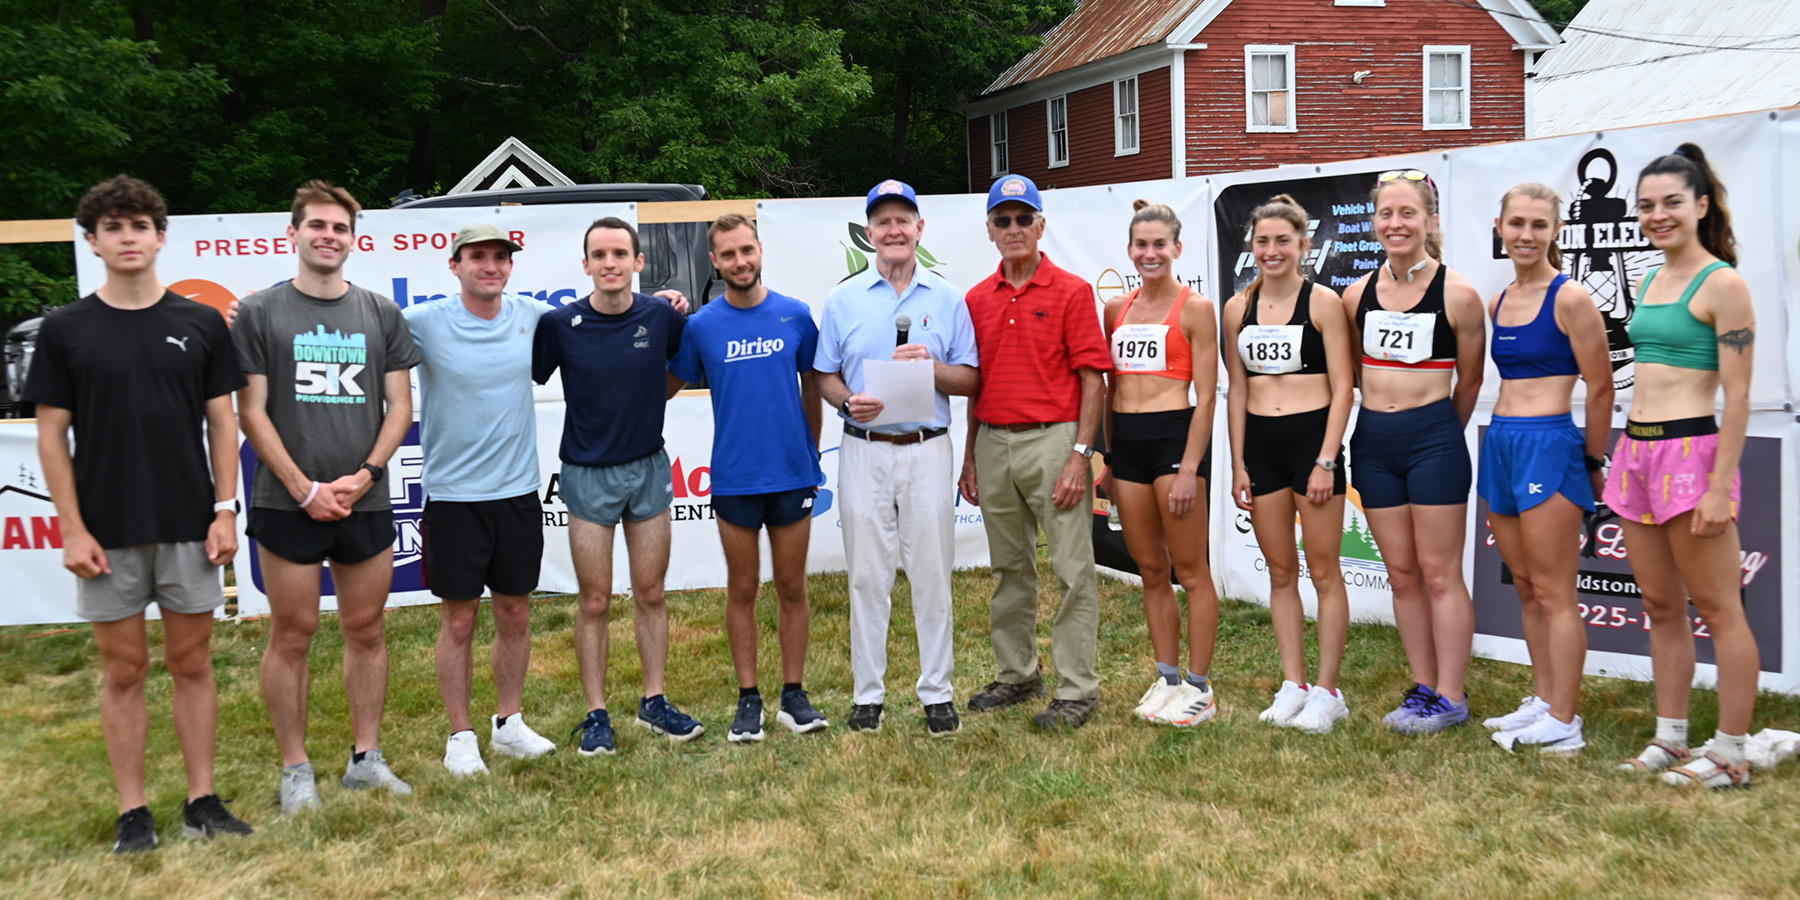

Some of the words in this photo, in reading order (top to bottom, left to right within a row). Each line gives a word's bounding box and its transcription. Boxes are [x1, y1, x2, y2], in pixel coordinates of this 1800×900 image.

[1332, 203, 1366, 216] Vehicle
[1338, 222, 1361, 234] Boat
[1592, 222, 1650, 249] ELEC
[195, 235, 375, 257] PRESEG
[393, 231, 525, 251] SPOR
[1334, 240, 1358, 253] Fleet
[1358, 240, 1385, 254] Grap
[1353, 258, 1379, 270] Paint
[1378, 328, 1414, 350] 721
[293, 345, 367, 364] DOWNTOWN
[724, 336, 785, 363] Dirigo
[1117, 340, 1158, 359] 1976
[1246, 342, 1292, 361] 1833
[1611, 350, 1627, 359] 018
[294, 361, 366, 396] 5K
[295, 393, 355, 404] PROVIDENCE
[355, 396, 366, 404] RI
[1343, 570, 1391, 592] COMM
[1576, 574, 1642, 594] ldston
